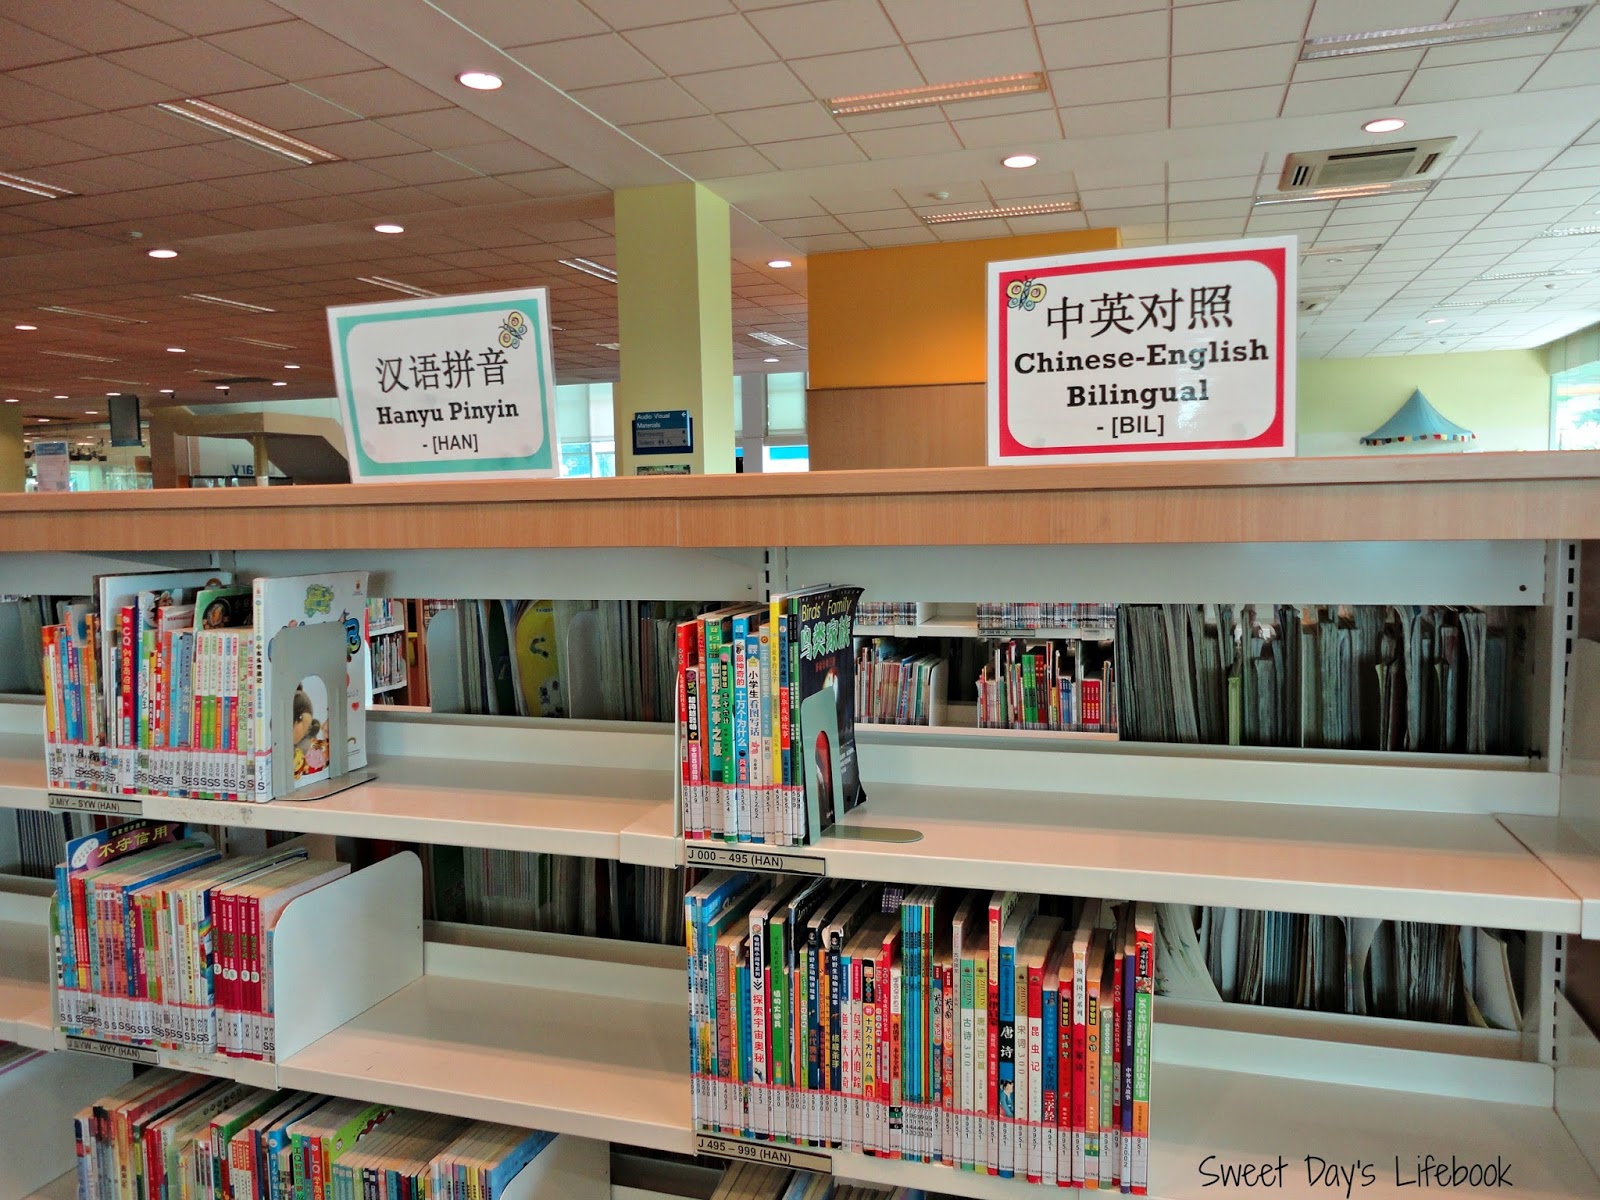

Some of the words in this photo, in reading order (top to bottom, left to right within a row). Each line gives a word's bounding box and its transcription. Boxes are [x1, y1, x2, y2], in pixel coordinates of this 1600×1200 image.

[1047, 284, 1233, 340] 中英对照
[376, 346, 509, 394] 汉语拼音
[1014, 339, 1269, 374] Chinese-English
[1067, 379, 1209, 410] Bilingual
[377, 403, 444, 428] Hanyu
[450, 399, 520, 424] Pinyin
[800, 614, 852, 661] 鸟类家族
[748, 670, 760, 737] 小学生看图写话
[98, 826, 168, 858] 不守信用
[697, 849, 716, 862] 000
[729, 852, 748, 863] 495
[751, 852, 784, 868] (HAN)
[753, 994, 764, 1063] 探索宇宙奥秘
[1000, 1025, 1014, 1058] 唐诗
[1031, 1026, 1040, 1071] 昆虫记
[1044, 1092, 1055, 1122] 三字经
[707, 1140, 726, 1151] 495
[738, 1145, 756, 1156] 999
[760, 1149, 791, 1165] (HAN)
